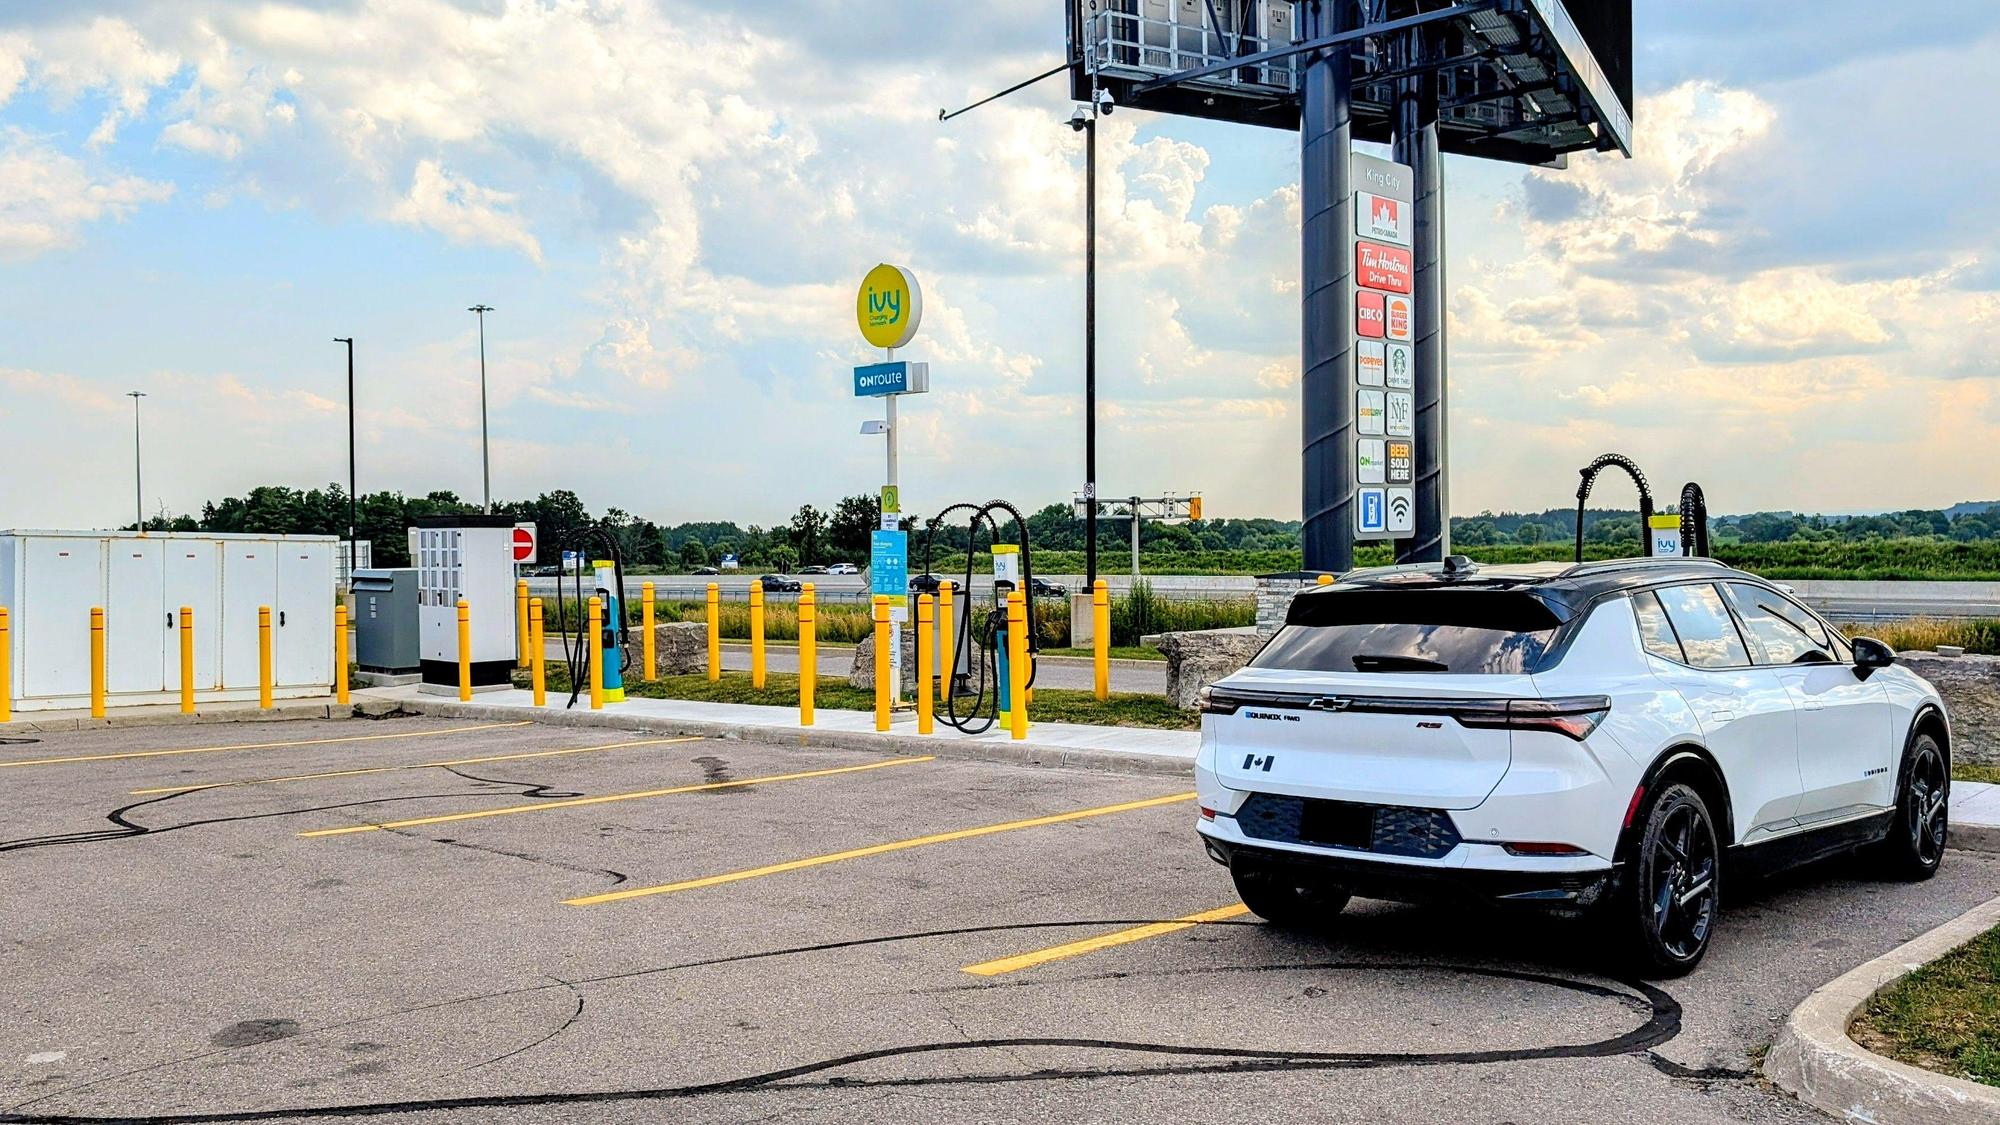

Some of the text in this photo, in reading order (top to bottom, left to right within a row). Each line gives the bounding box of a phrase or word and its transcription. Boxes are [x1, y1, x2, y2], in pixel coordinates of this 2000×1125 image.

[1366, 168, 1400, 191] King City
[1361, 248, 1408, 274] Tim Hortons
[1369, 271, 1402, 287] Drive Thru
[869, 286, 900, 324] ivy
[1360, 307, 1376, 320] CIBC
[1391, 319, 1407, 330] KING
[1360, 355, 1383, 367] POPEYES
[860, 372, 902, 388] ONroute
[1360, 408, 1383, 417] SUBWAY
[1391, 398, 1408, 422] NYF
[1390, 444, 1409, 457] BEER
[1391, 458, 1409, 469] SOLD
[1391, 469, 1409, 480] HERE
[1658, 538, 1675, 552] ivy
